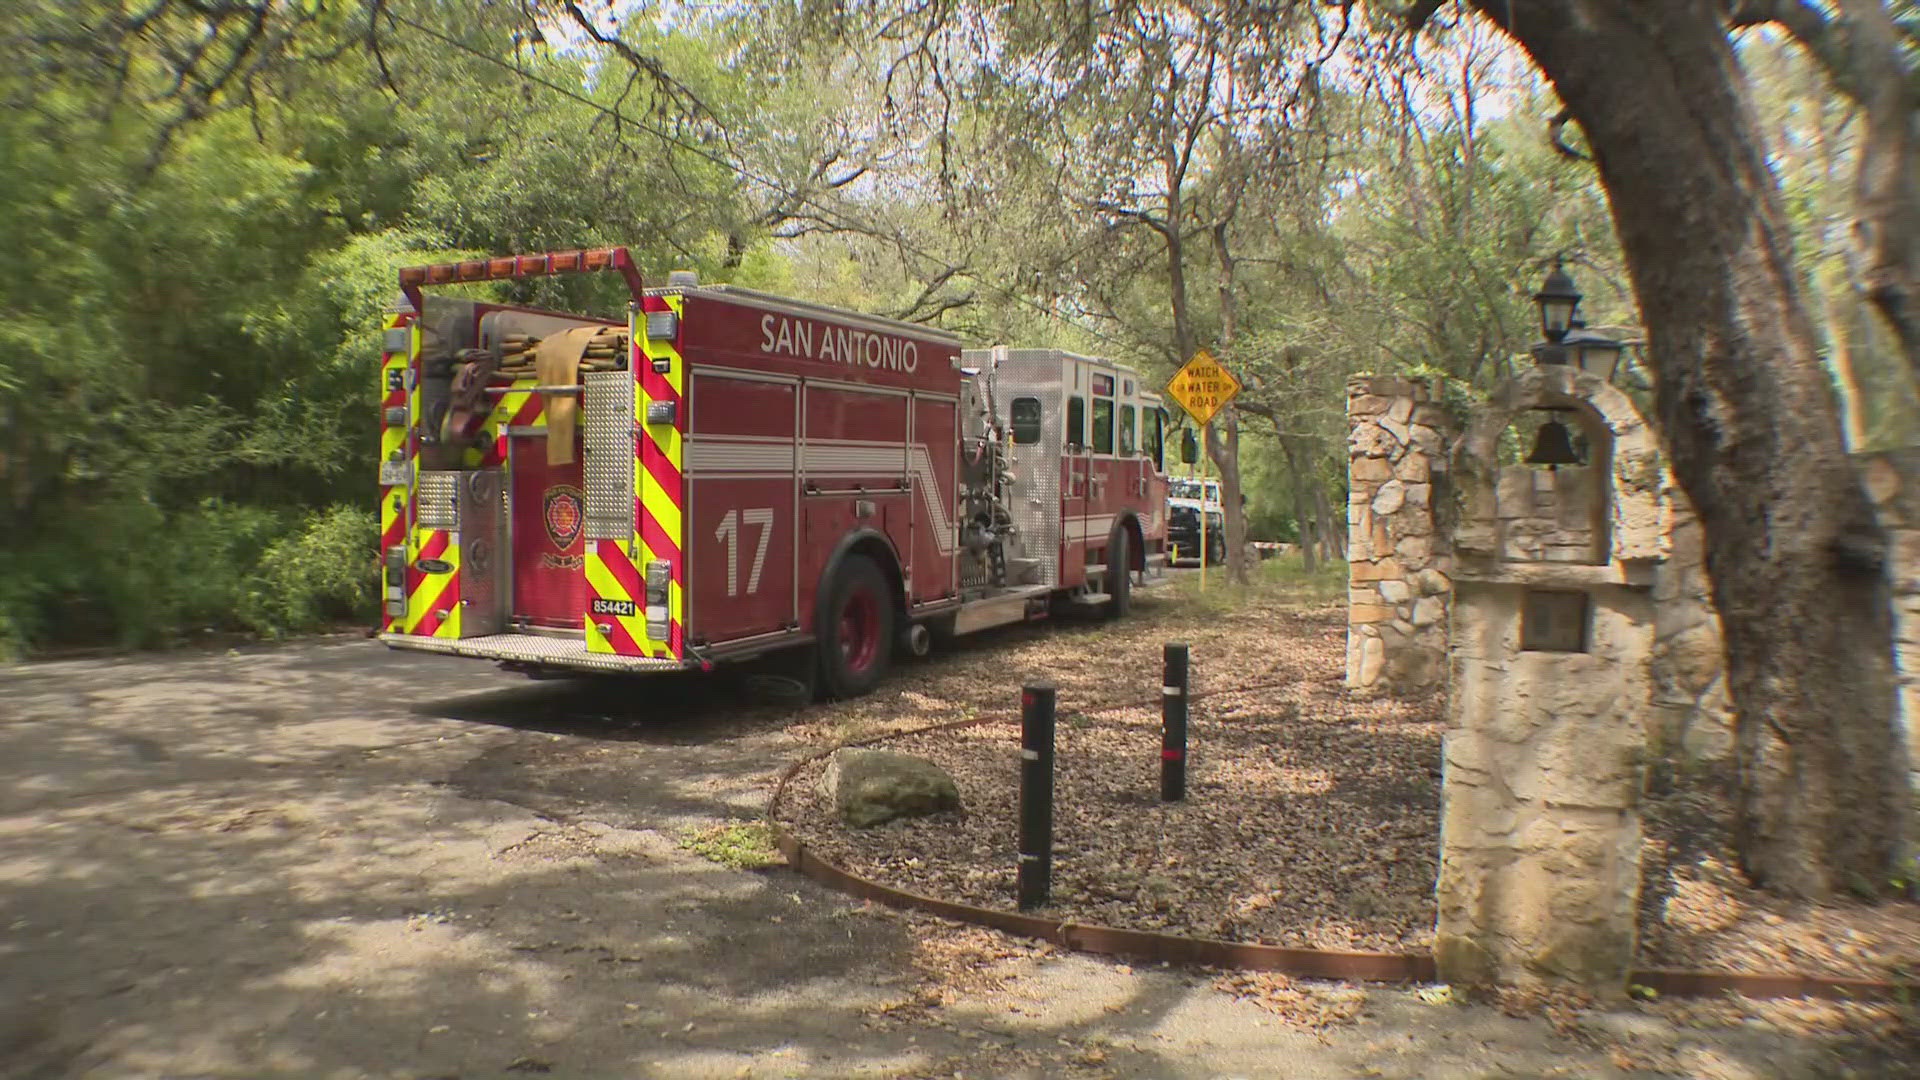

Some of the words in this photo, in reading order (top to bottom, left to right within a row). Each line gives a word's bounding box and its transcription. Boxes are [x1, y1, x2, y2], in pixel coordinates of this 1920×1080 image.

[761, 314, 812, 359] SAN
[819, 326, 918, 373] ANTONIO
[1187, 366, 1219, 378] WATCH
[1187, 381, 1219, 393] WATER
[1189, 396, 1217, 408] ROAD
[714, 507, 774, 597] 17
[593, 600, 634, 615] 854421
